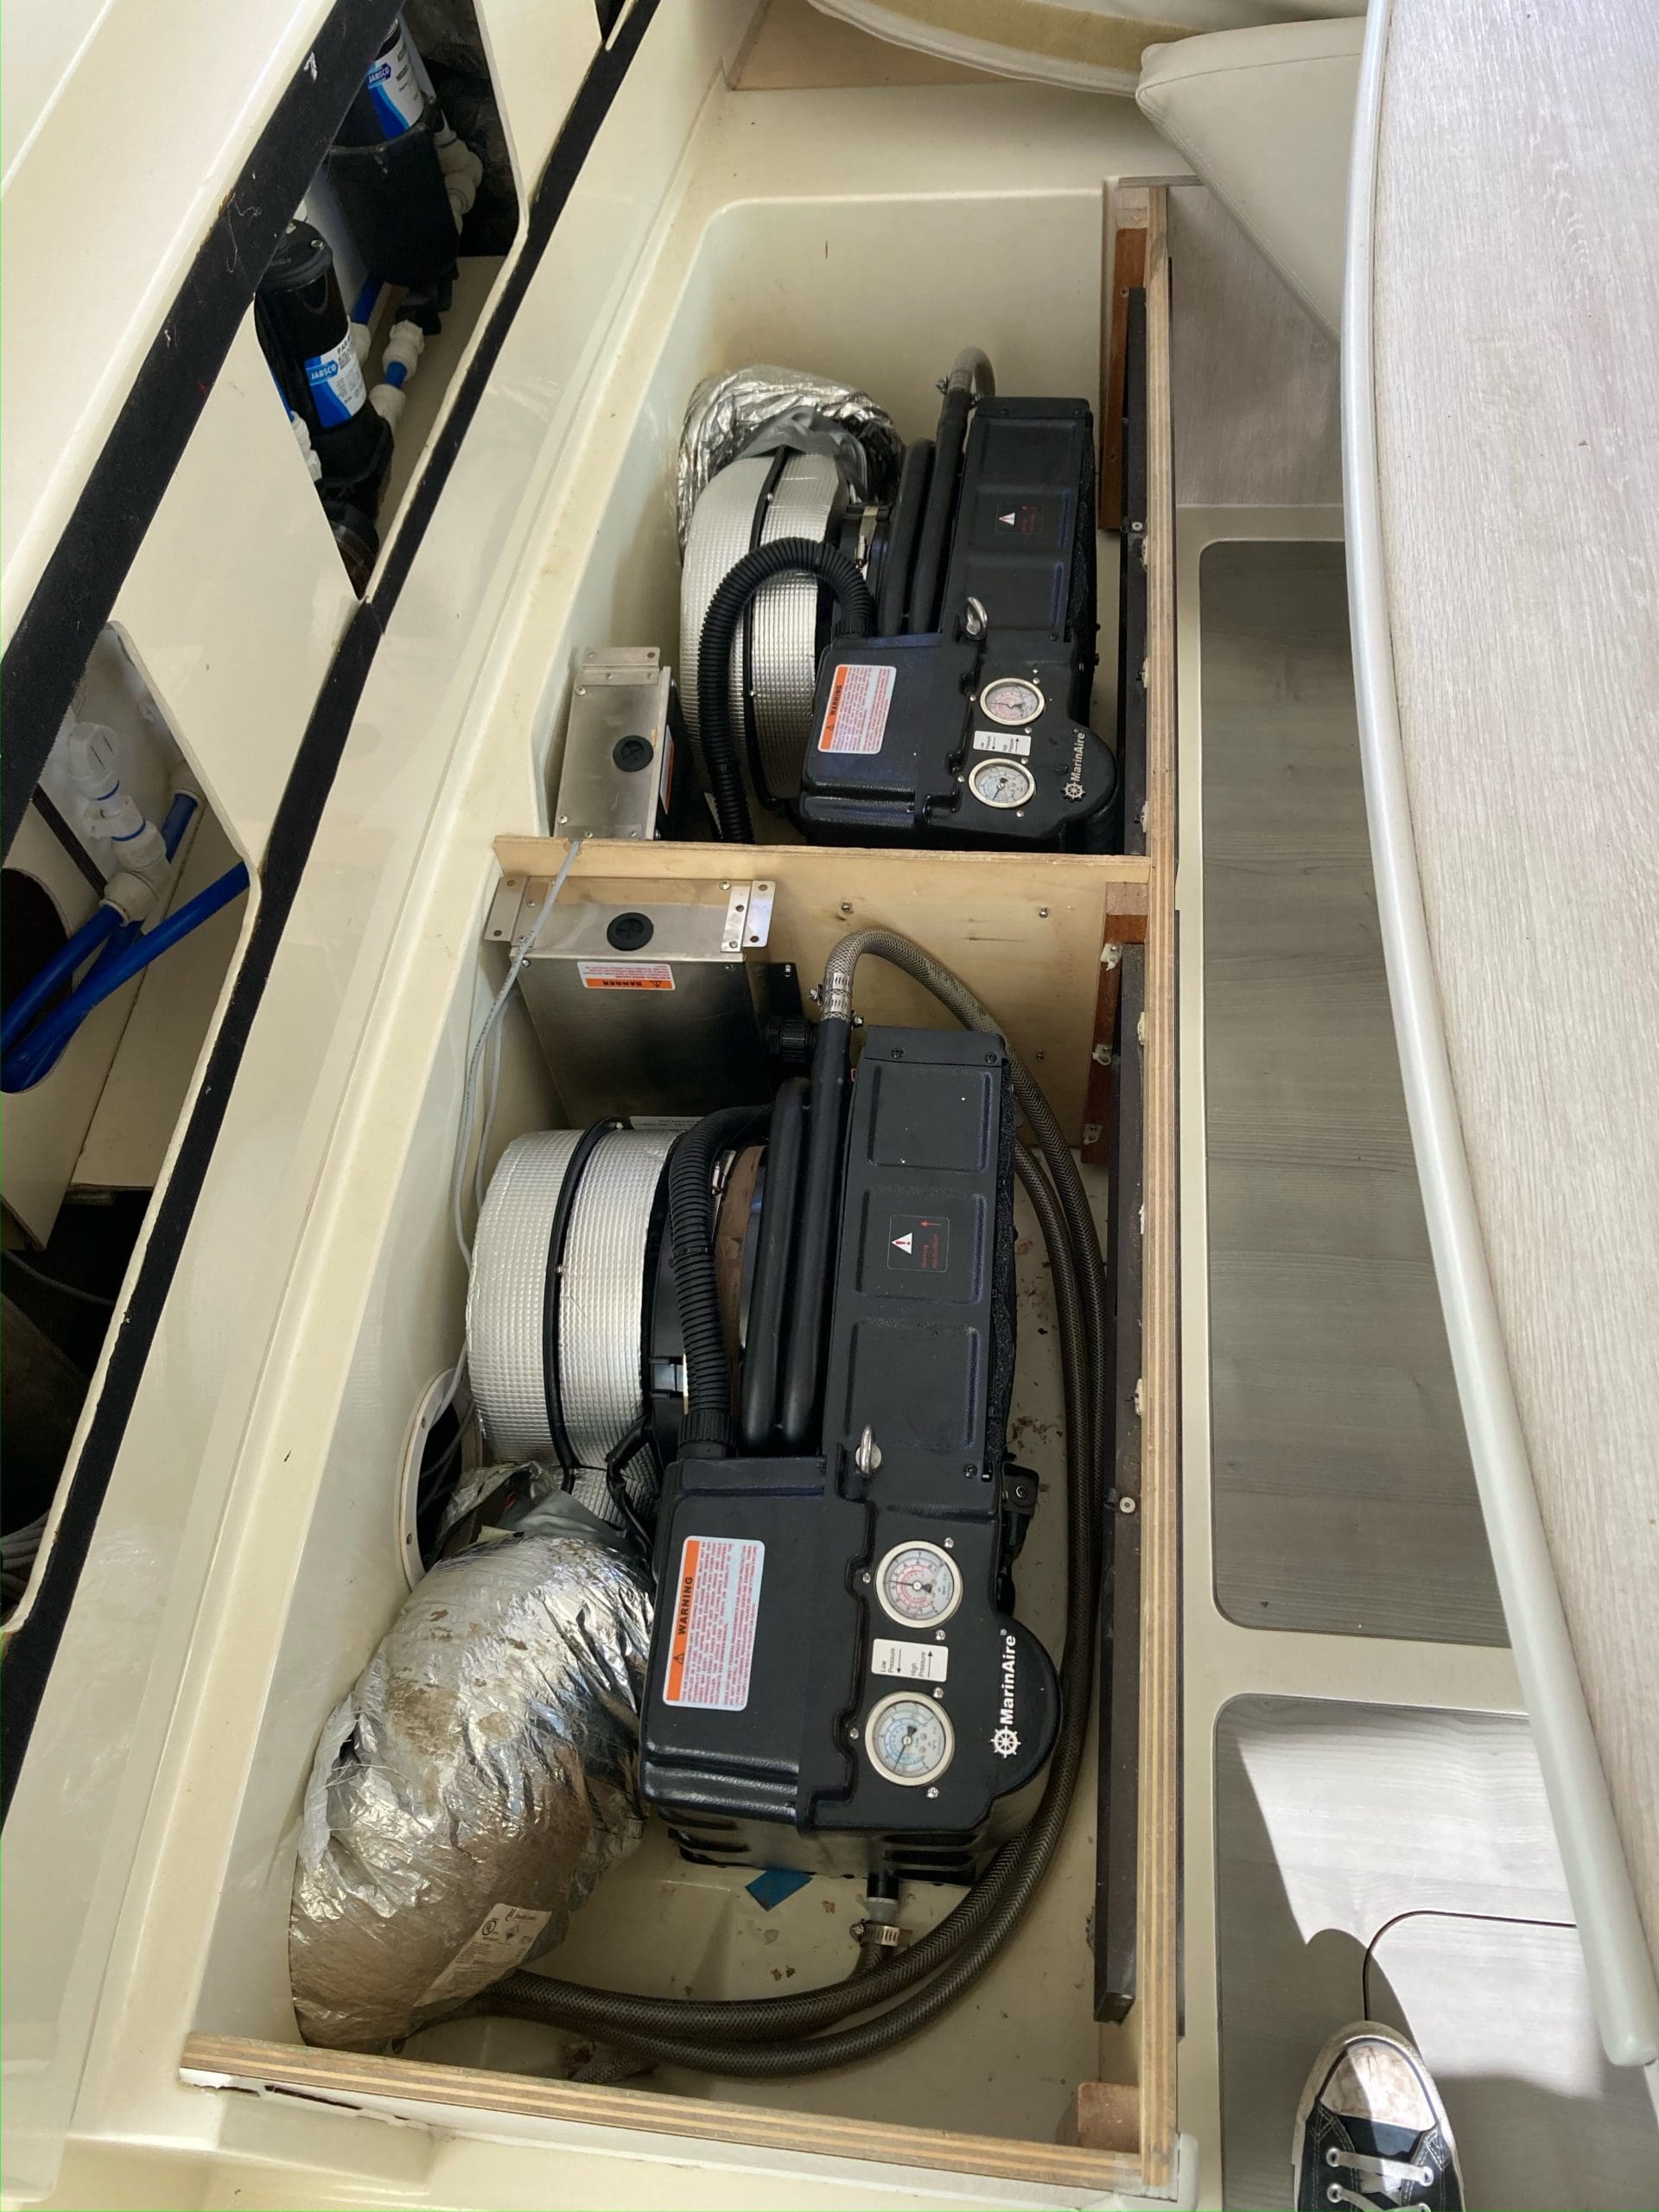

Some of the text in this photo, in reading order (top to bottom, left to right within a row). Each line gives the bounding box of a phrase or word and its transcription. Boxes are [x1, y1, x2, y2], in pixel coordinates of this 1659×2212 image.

[311, 364, 336, 380] JABSCO
[829, 685, 842, 715] WARNING
[1071, 733, 1085, 782] MarinAire
[678, 1576, 692, 1635] WARNING
[1000, 1635, 1016, 1725] MarinAire
